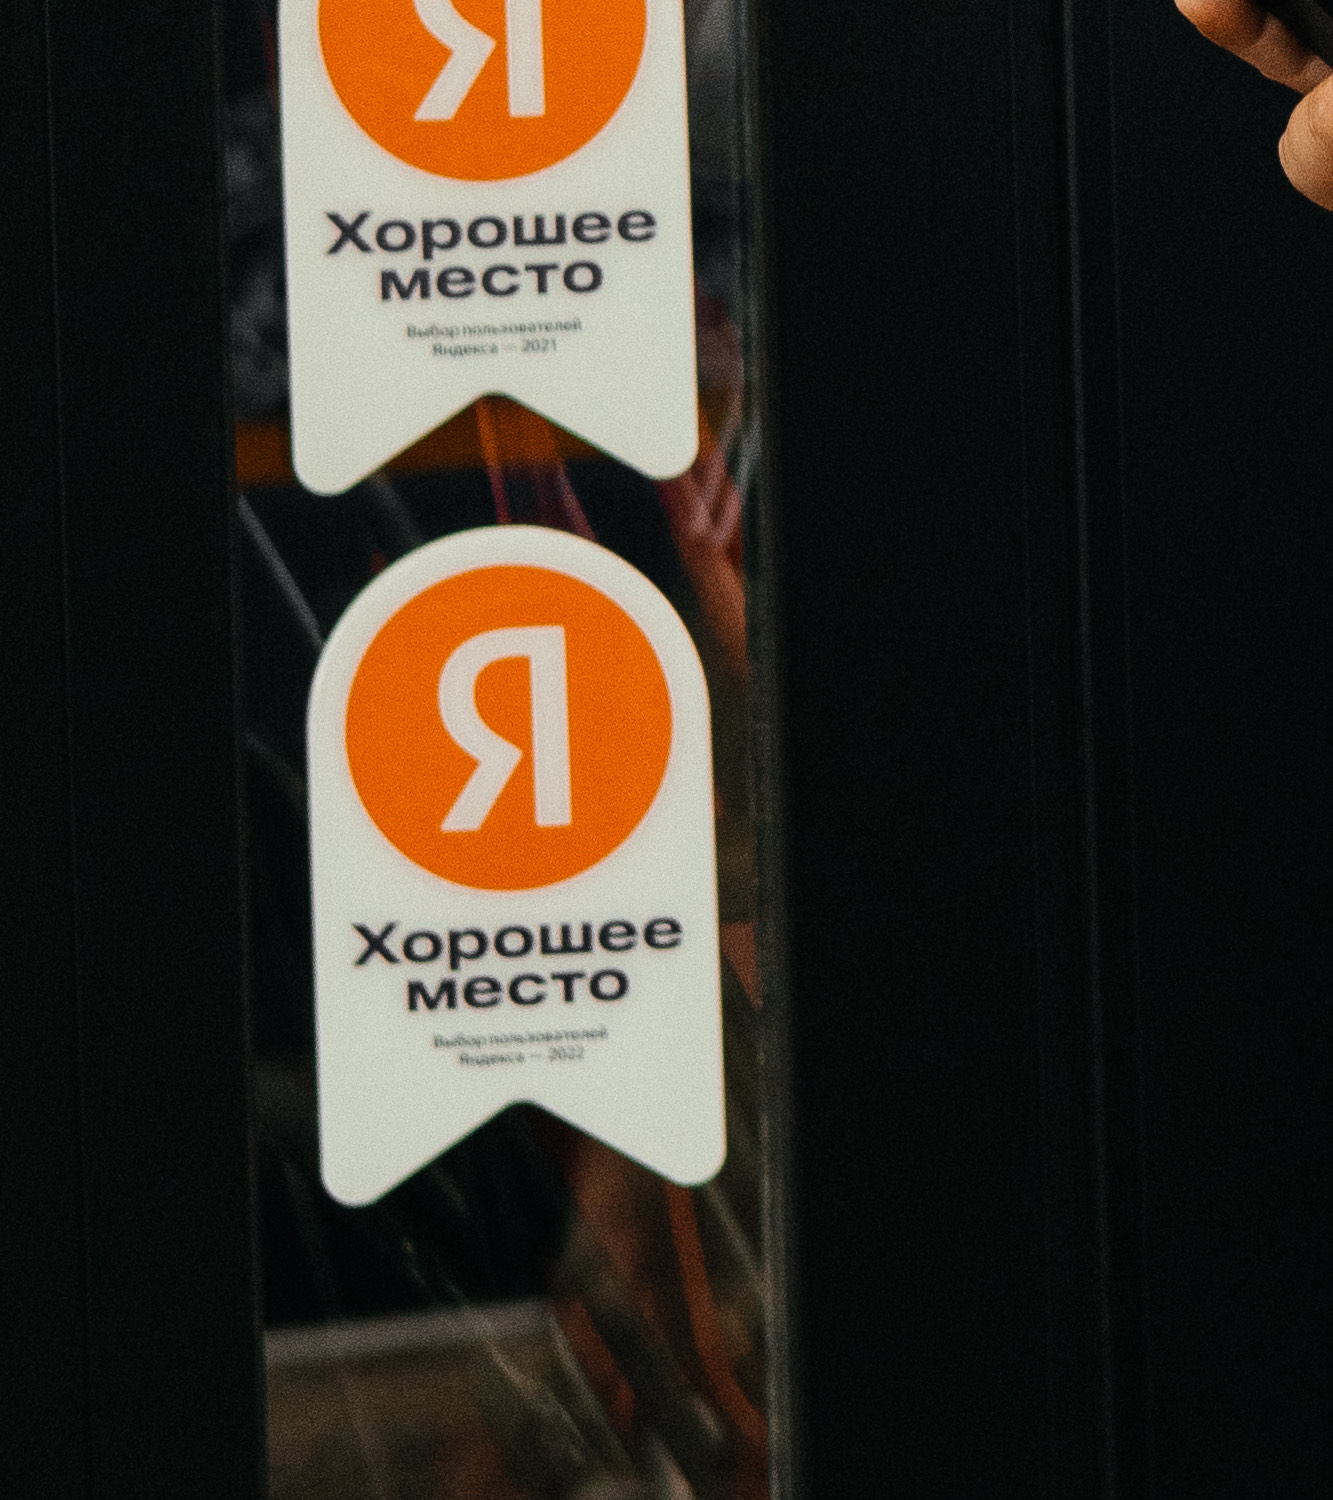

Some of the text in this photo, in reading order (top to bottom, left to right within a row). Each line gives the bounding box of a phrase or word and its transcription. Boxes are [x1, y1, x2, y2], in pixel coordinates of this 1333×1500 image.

[323, 208, 658, 260] Хорошее
[379, 259, 604, 303] место
[437, 623, 573, 834] Я
[352, 914, 685, 971] Хорошее
[406, 967, 629, 1014] место
